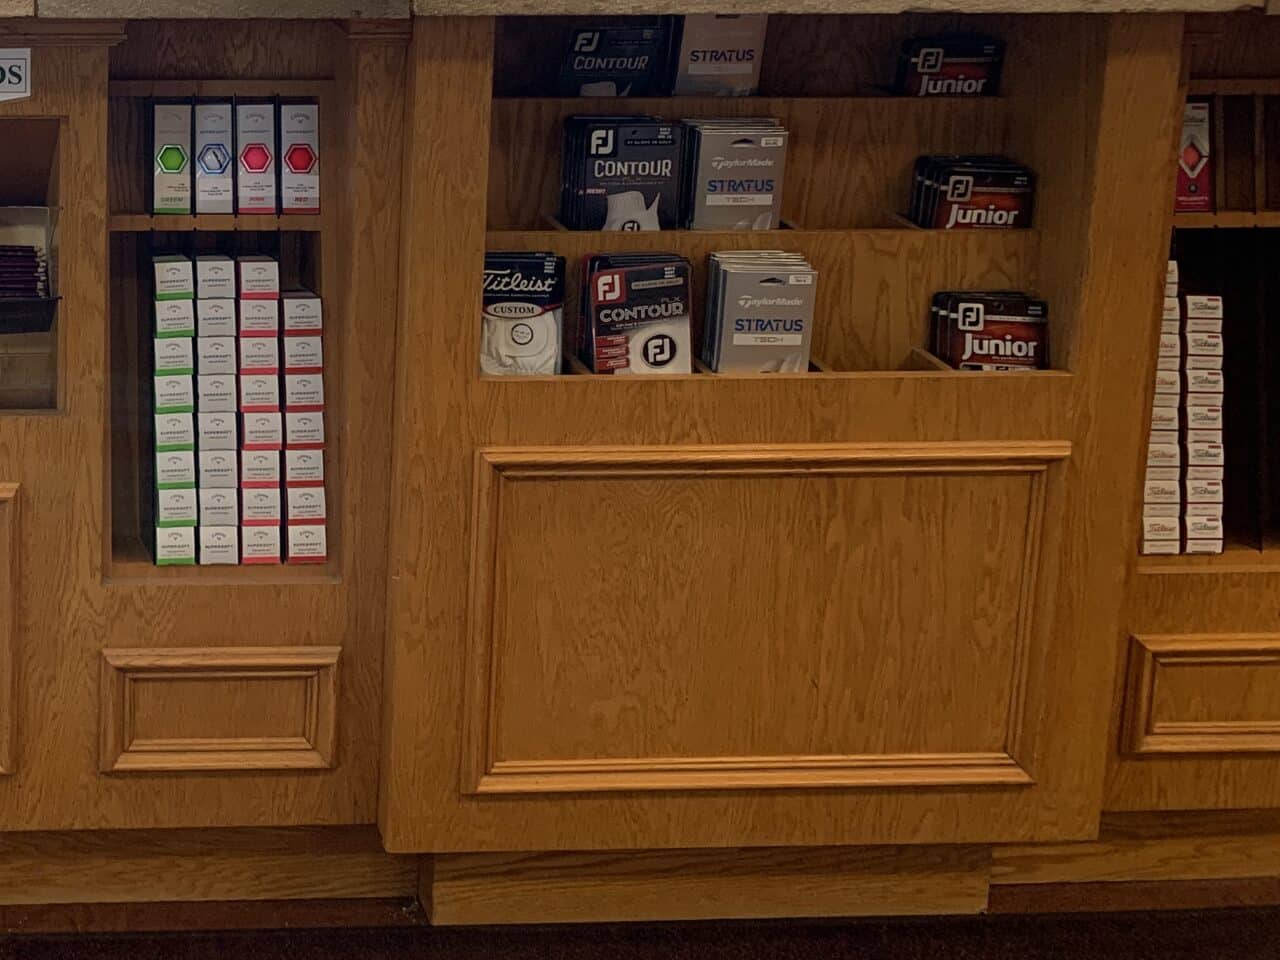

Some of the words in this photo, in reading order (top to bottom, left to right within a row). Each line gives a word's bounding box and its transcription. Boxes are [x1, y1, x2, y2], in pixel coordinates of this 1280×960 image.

[573, 56, 649, 71] CONTOUR
[689, 49, 754, 63] STRATUS
[920, 74, 987, 96] Junior
[594, 159, 672, 177] CONTOUR
[707, 179, 774, 193] STRATUS
[946, 205, 1019, 229] Junior
[484, 268, 556, 292] Titleist
[494, 305, 535, 315] CUSTOM
[599, 301, 684, 323] CONTOUR
[733, 317, 804, 333] STRATUS
[961, 333, 1038, 361] Junior
